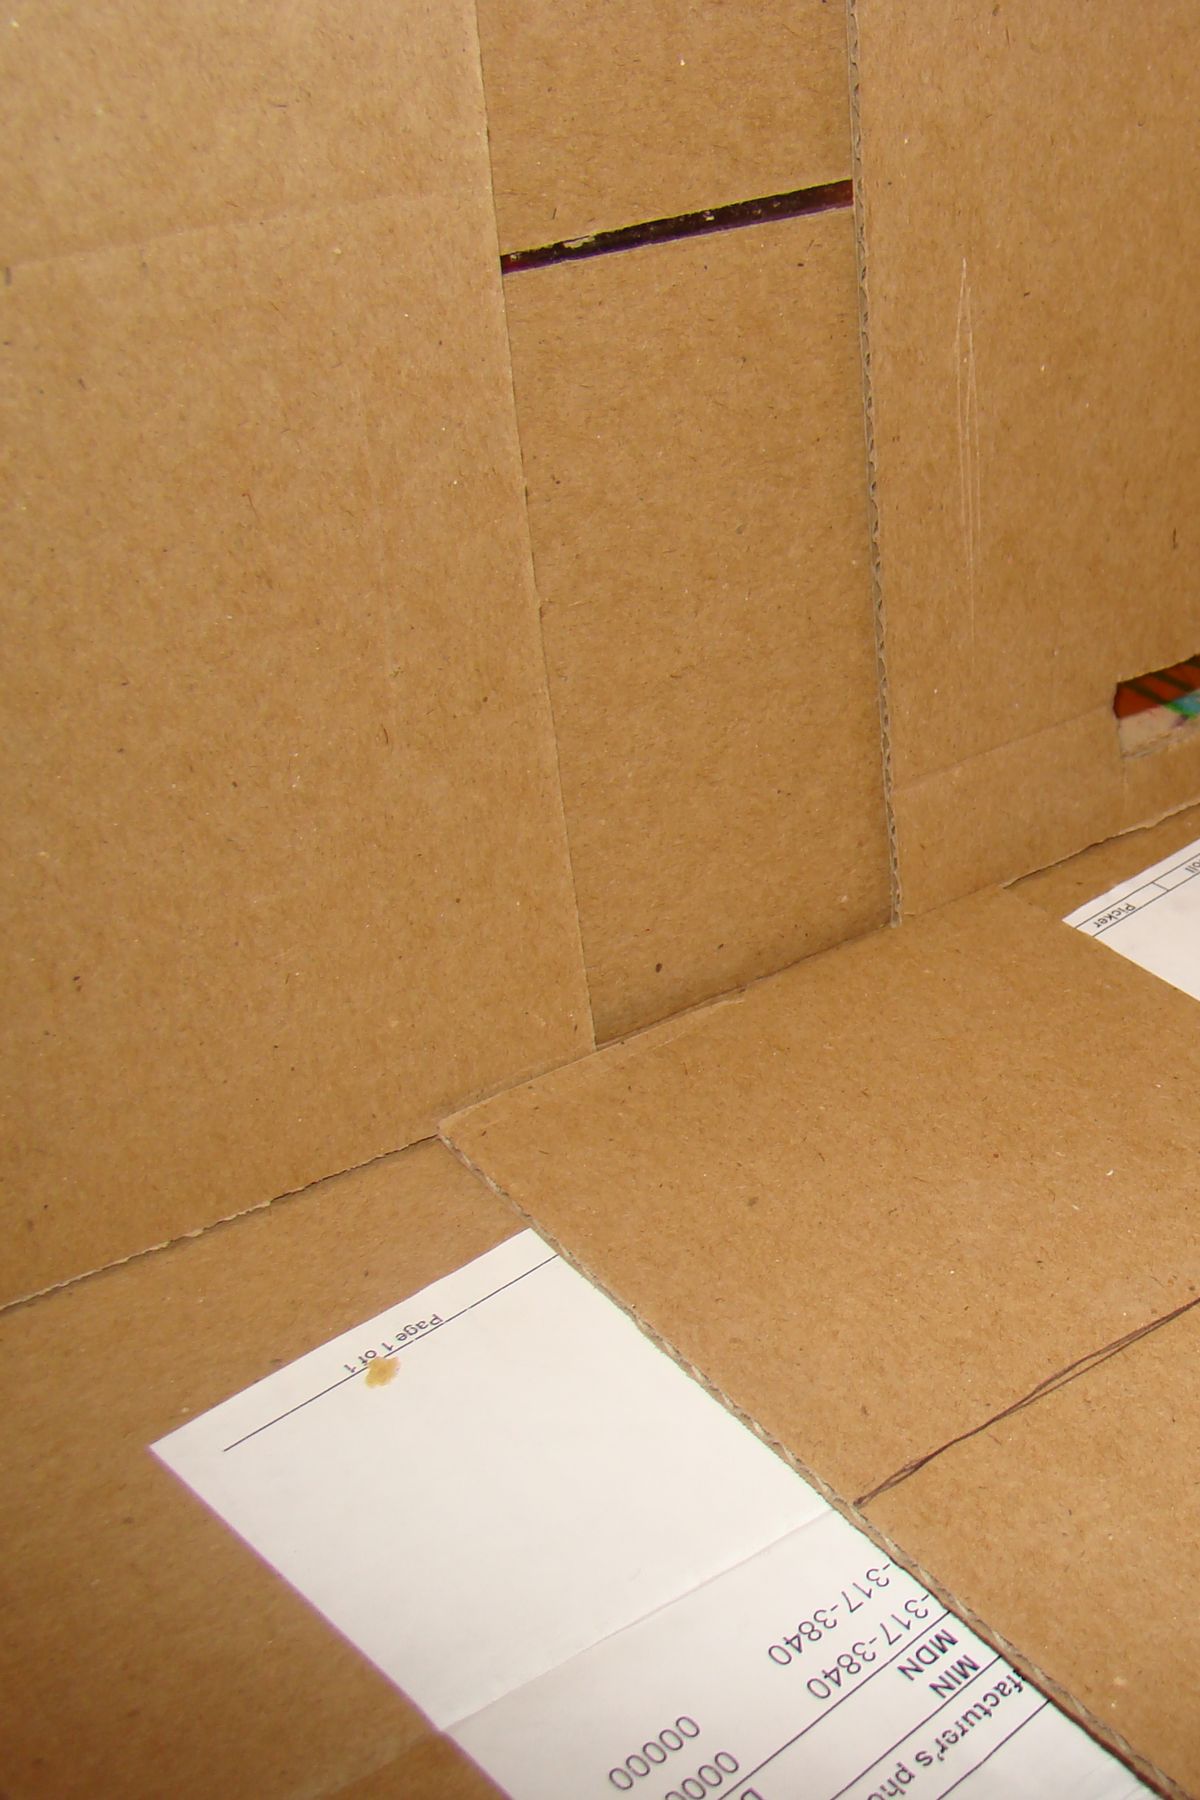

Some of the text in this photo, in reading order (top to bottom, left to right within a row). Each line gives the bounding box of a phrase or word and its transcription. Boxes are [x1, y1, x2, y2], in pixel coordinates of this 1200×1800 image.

[1093, 903, 1136, 928] Picker
[343, 1313, 443, 1373] Page 1 of 1
[897, 1629, 959, 1681] MDN
[928, 1654, 981, 1699] MIN
[914, 1669, 1026, 1767] facturer's
[609, 1716, 700, 1790] 00000
